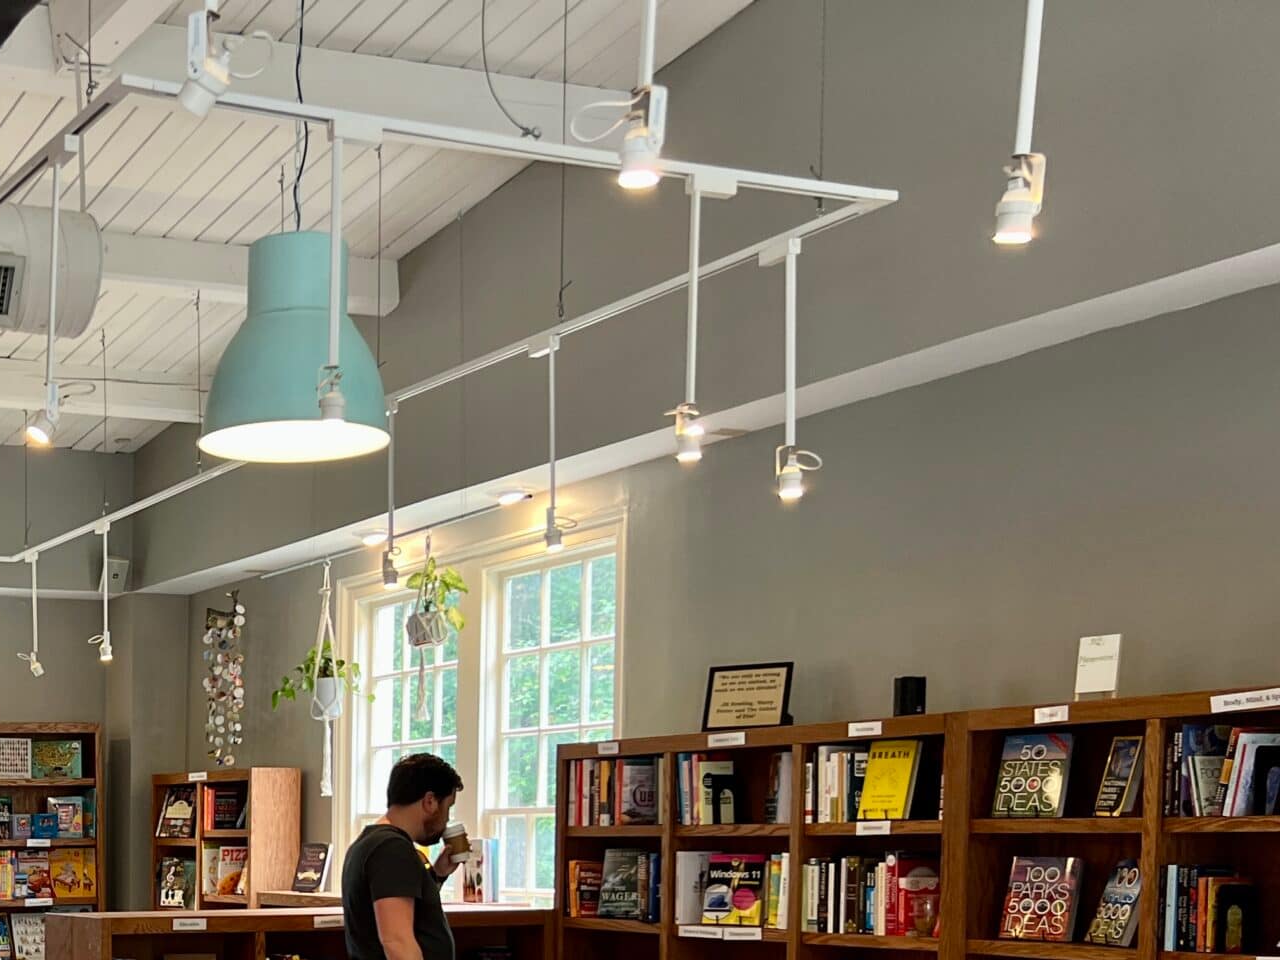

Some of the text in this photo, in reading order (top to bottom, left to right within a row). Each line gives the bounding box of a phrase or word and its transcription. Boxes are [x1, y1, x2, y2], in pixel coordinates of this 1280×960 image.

[871, 751, 910, 760] BREATH
[1020, 744, 1047, 760] 50
[1002, 760, 1061, 777] STATES
[999, 777, 1058, 793] 5000
[996, 793, 1055, 811] IDEAS
[710, 869, 761, 879] Windows 11
[1025, 866, 1060, 882] 100
[1011, 882, 1070, 900] PARKS
[1007, 898, 1066, 916] 5000
[1004, 915, 1065, 935] IDEAS
